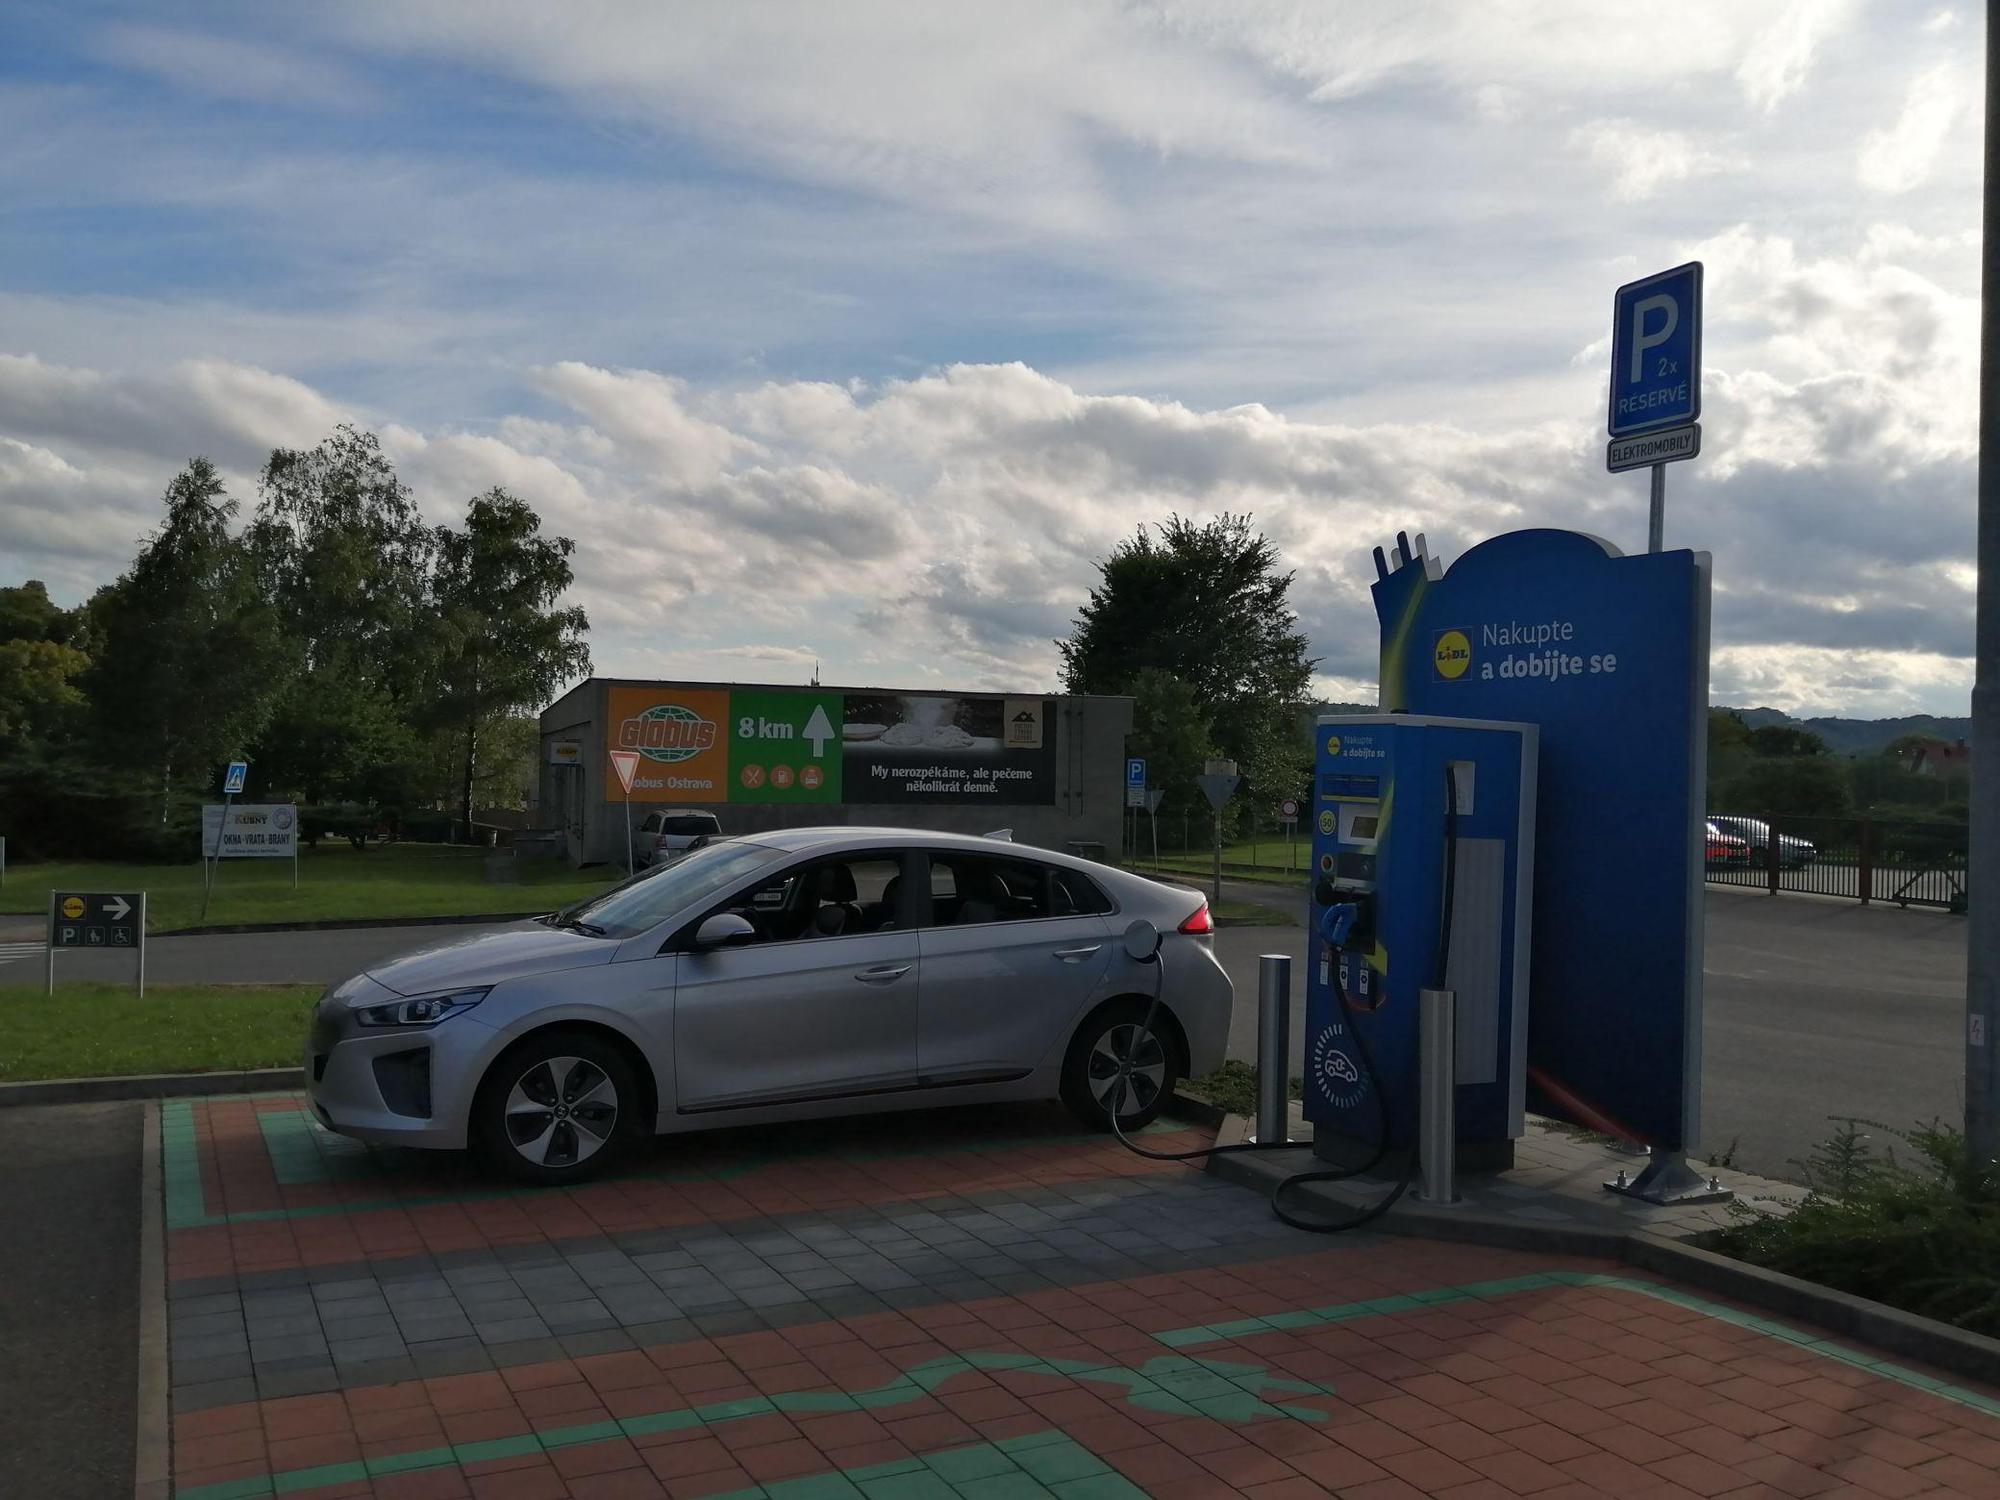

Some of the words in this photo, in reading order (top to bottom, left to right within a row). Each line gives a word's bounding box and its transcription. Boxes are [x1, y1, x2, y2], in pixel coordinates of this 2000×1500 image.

[1630, 293, 1679, 384] P
[1658, 357, 1678, 377] 2x
[1618, 380, 1689, 415] RÉSERVÉ
[1612, 434, 1691, 463] ELEKTROMOBILY
[1482, 620, 1574, 648] Nakupte
[1481, 661, 1494, 680] a
[1499, 650, 1583, 682] dobijte
[1590, 653, 1617, 673] se
[738, 717, 755, 739] 8
[759, 716, 793, 740] km
[633, 776, 664, 789] obus
[667, 776, 713, 790] Ostrava
[871, 765, 889, 780] My
[973, 767, 989, 779] ale
[992, 767, 1033, 781] pečeme
[1131, 763, 1142, 779] P
[63, 928, 76, 943] P
